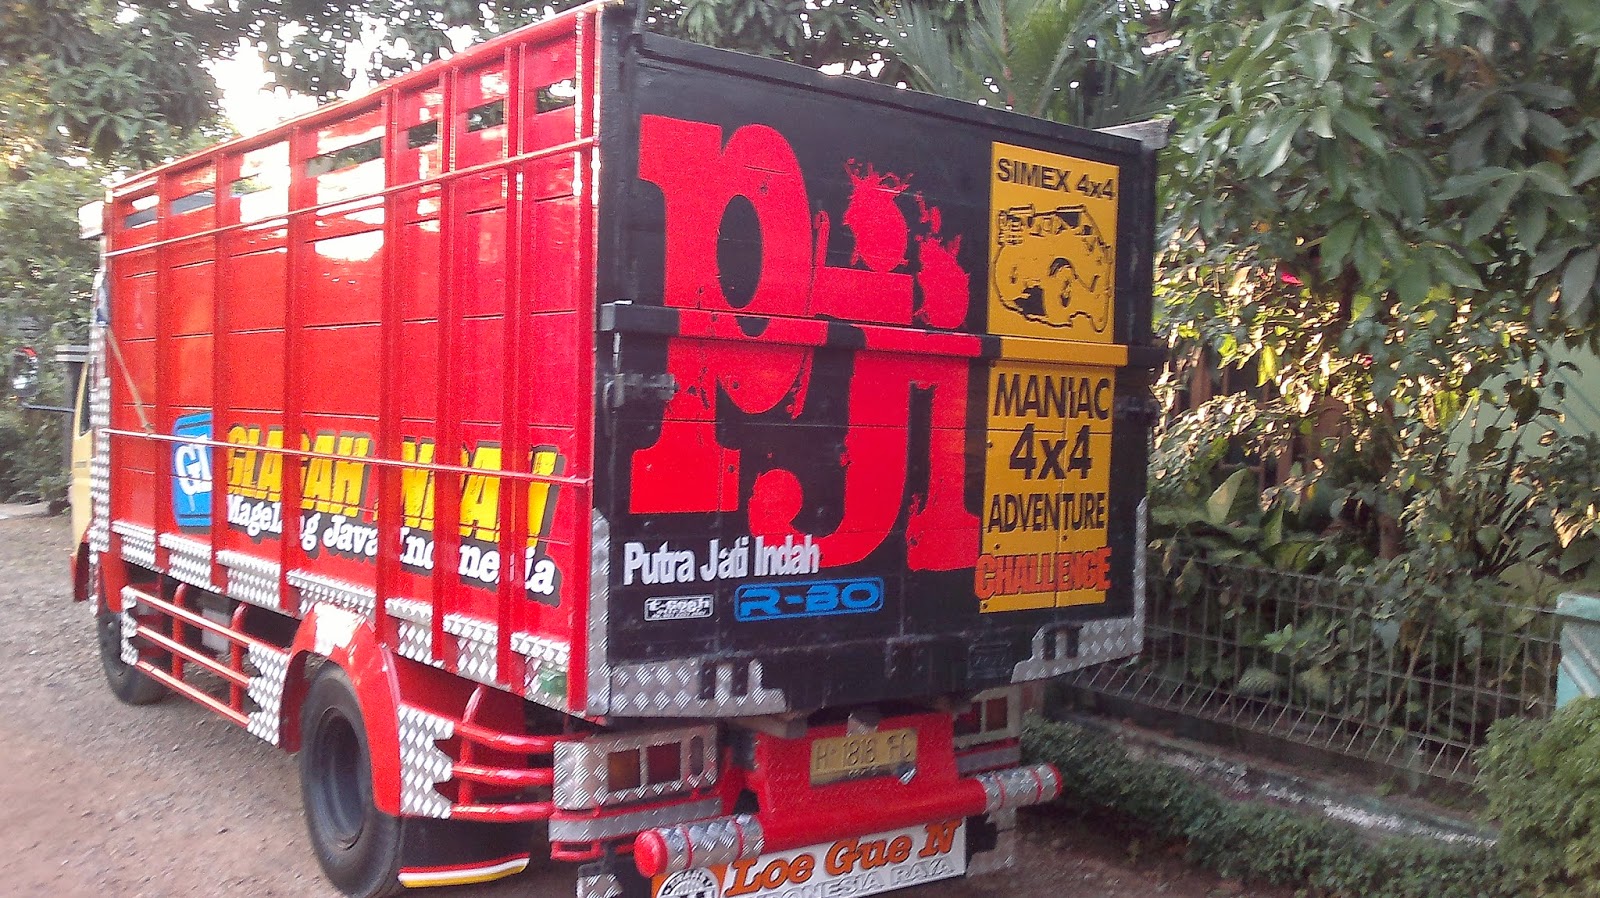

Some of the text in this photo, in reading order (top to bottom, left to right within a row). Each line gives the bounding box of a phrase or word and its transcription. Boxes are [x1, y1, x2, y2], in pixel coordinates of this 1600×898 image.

[997, 158, 1116, 200] SIMEX 4x4
[1009, 423, 1092, 480] 4x4
[987, 492, 1105, 533] ADVENTURE
[400, 526, 554, 596] Inneia
[623, 533, 820, 585] Putra Jati Indah
[974, 547, 1112, 600] CHALLENGE
[725, 857, 815, 897] Loe
[825, 836, 912, 876] Gue
